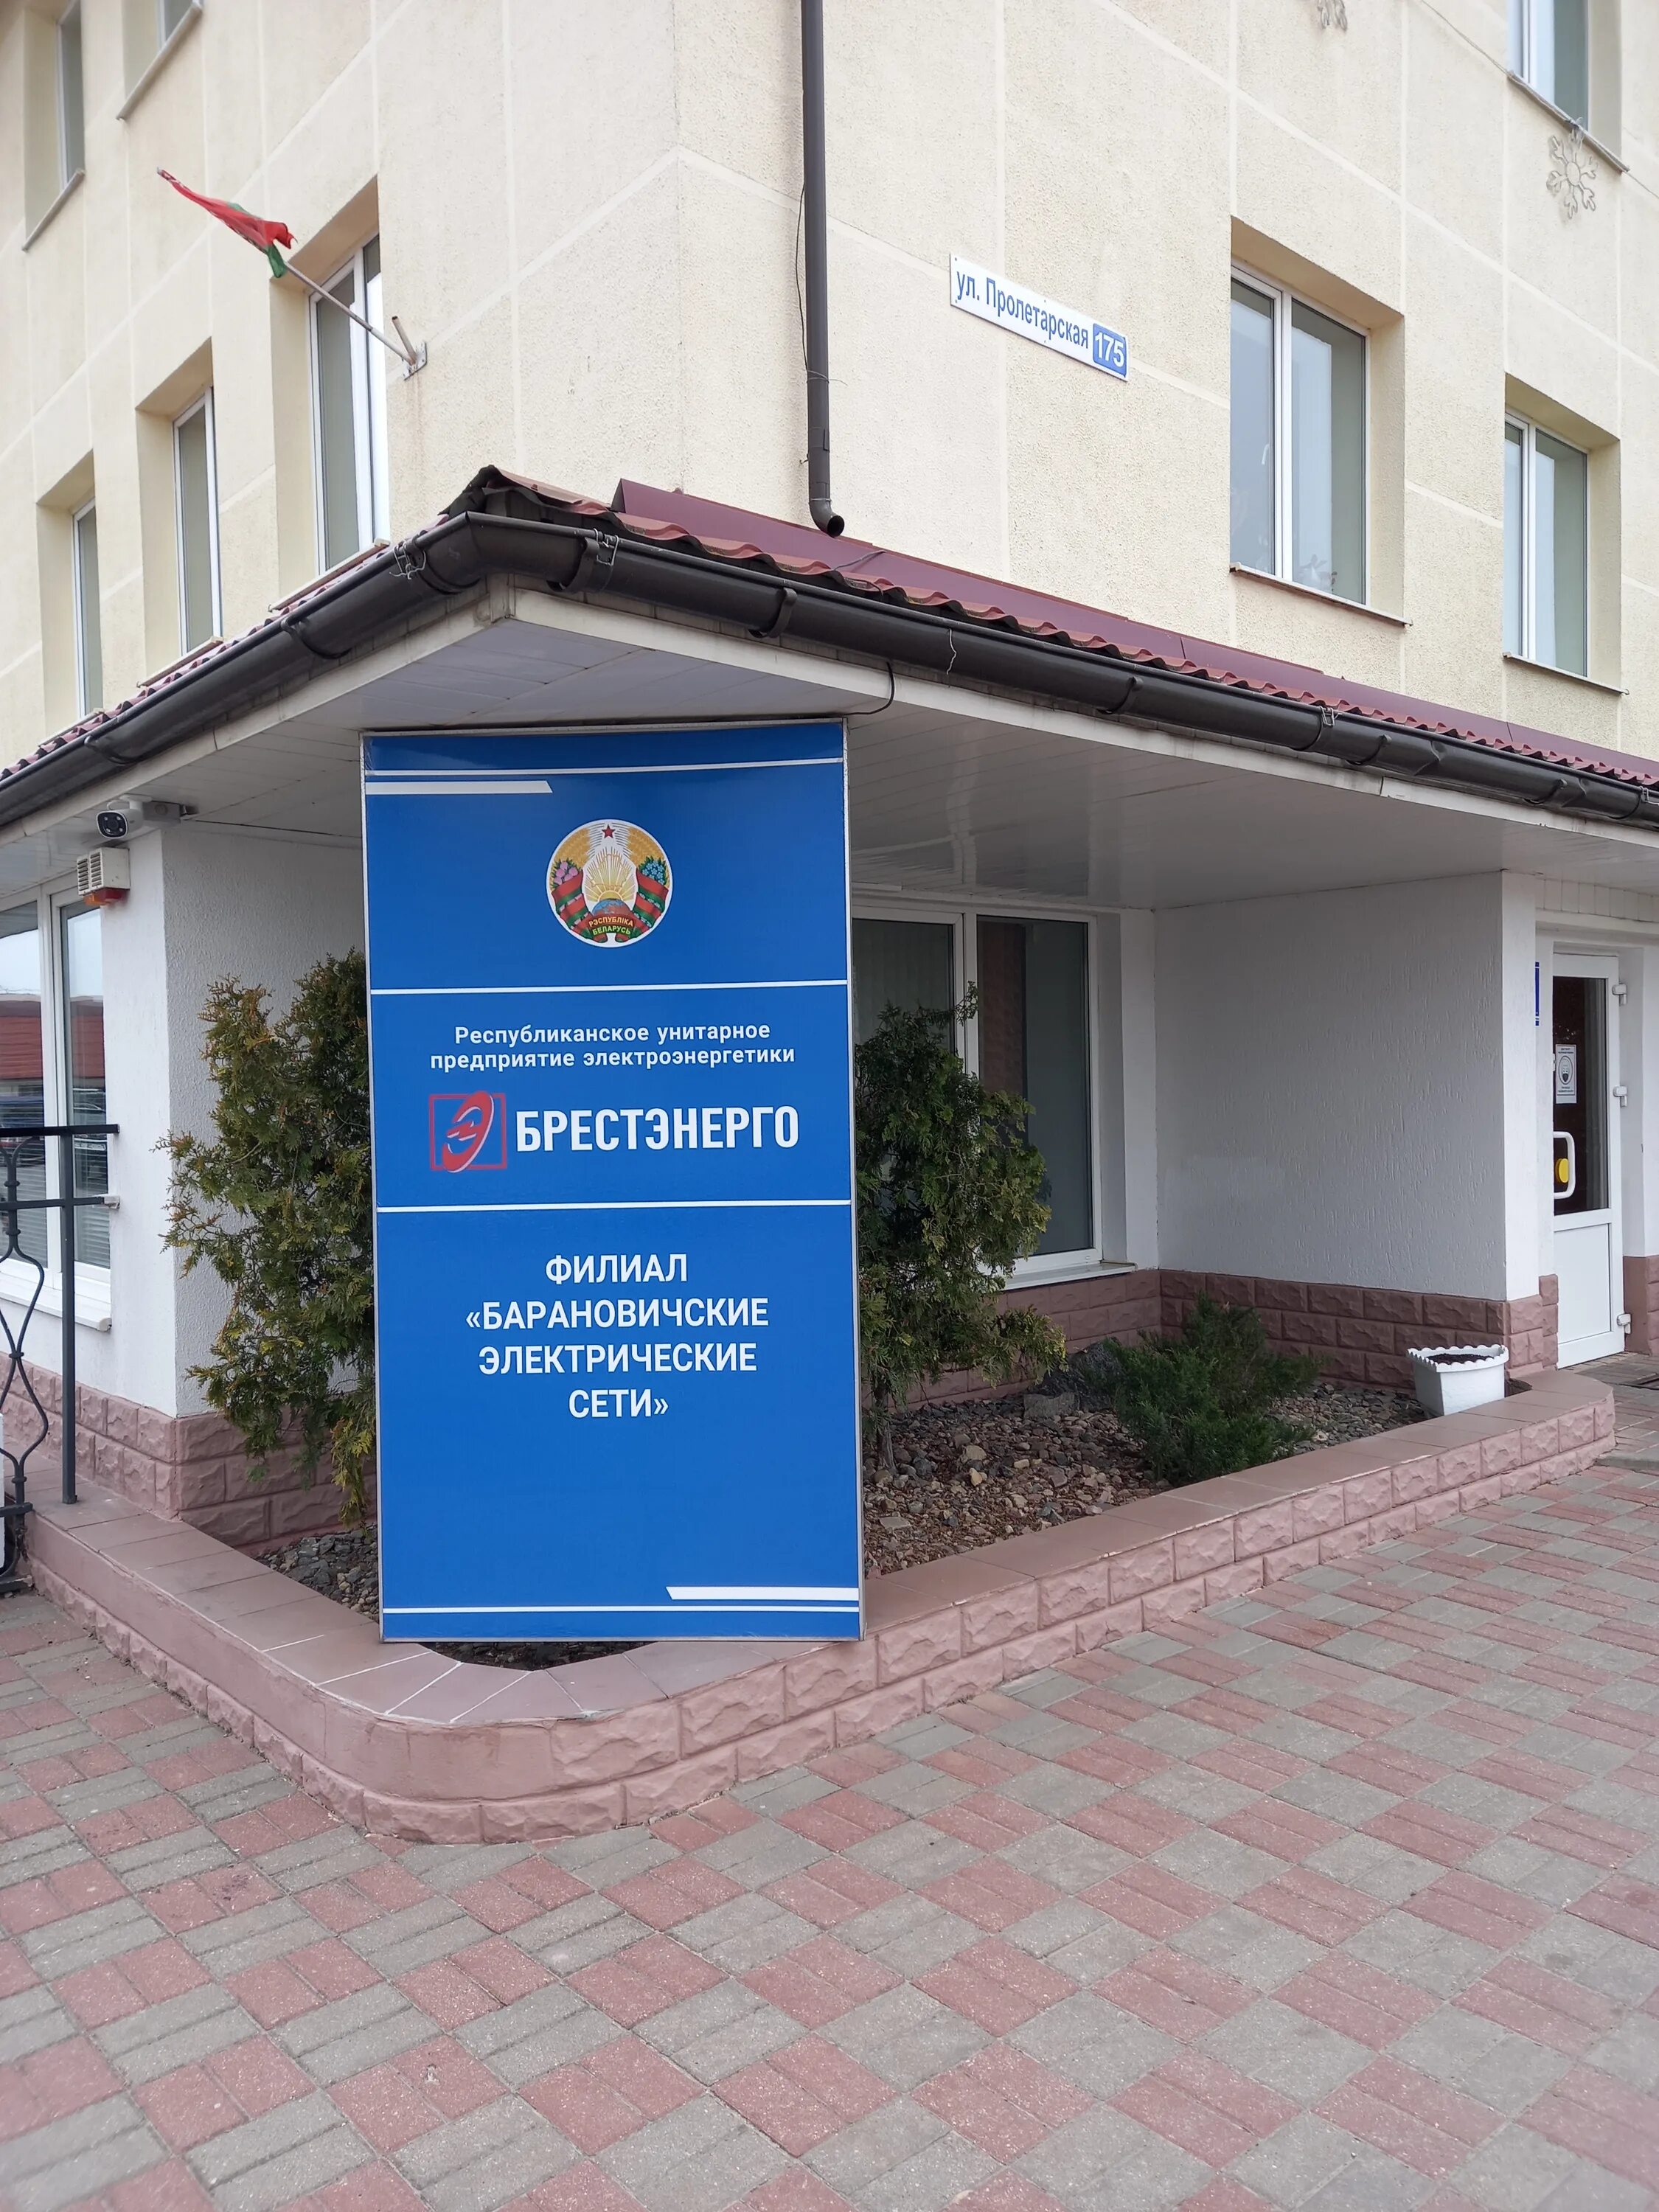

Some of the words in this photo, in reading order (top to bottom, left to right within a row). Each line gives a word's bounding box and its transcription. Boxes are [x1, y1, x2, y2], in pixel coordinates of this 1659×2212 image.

[957, 271, 980, 300] ул.
[986, 276, 1088, 349] Пролетарская
[1095, 331, 1124, 367] 175
[588, 916, 633, 928] РЭСПУБЛІКА
[592, 925, 631, 936] БЕЛАРУСЬ
[455, 1024, 649, 1047] Республиканское
[657, 1023, 771, 1045] унитарное
[430, 1050, 575, 1072] предприятие
[583, 1046, 796, 1069] электроэнергетики
[515, 1105, 800, 1152] БРЕСТЭНЕРГО
[545, 1253, 688, 1284] ФИЛИАЛ
[465, 1297, 769, 1330] «БАРАНОВИЧСКИЕ
[479, 1343, 757, 1374] ЭЛЕКТРИЧЕСКИЕ
[568, 1388, 669, 1418] СЕТИ»
